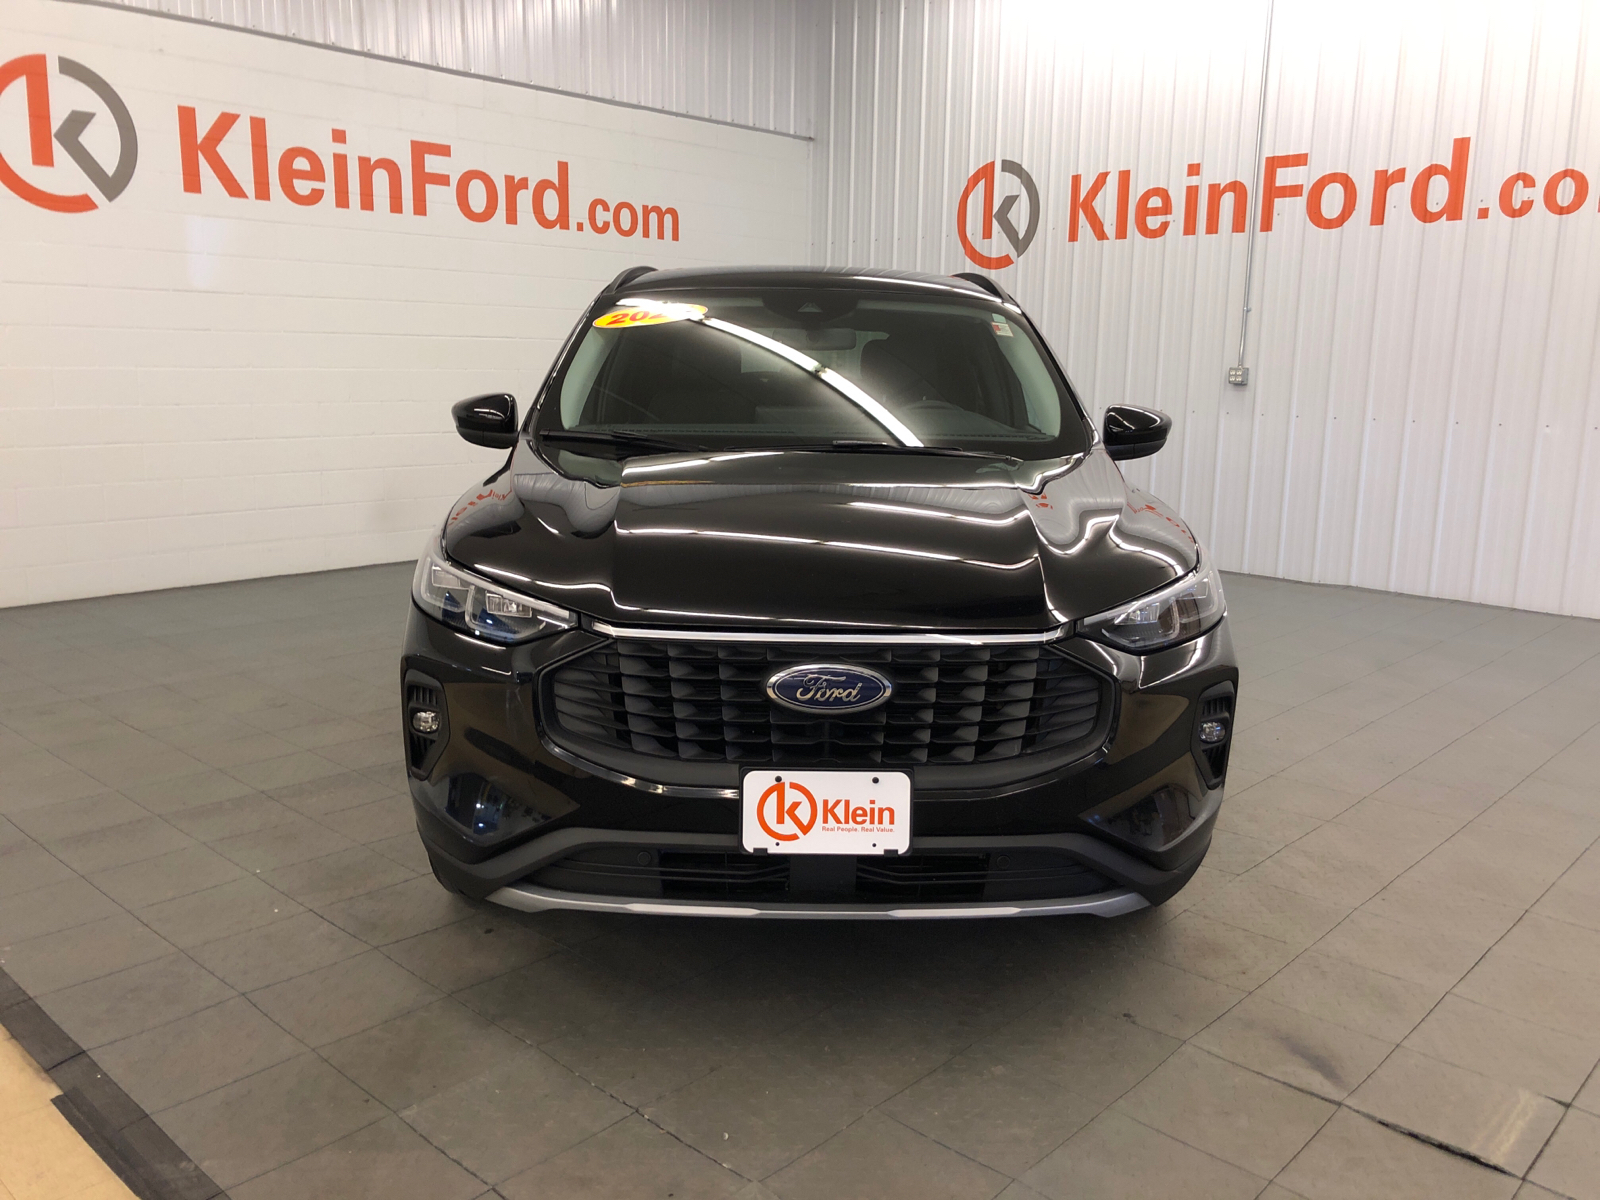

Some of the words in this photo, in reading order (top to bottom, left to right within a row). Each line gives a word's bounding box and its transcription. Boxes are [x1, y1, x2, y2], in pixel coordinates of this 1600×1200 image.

[177, 105, 680, 242] KleinFord.com
[1067, 137, 1600, 243] KleinFord.co
[796, 674, 863, 702] Ford
[822, 800, 895, 825] Klein
